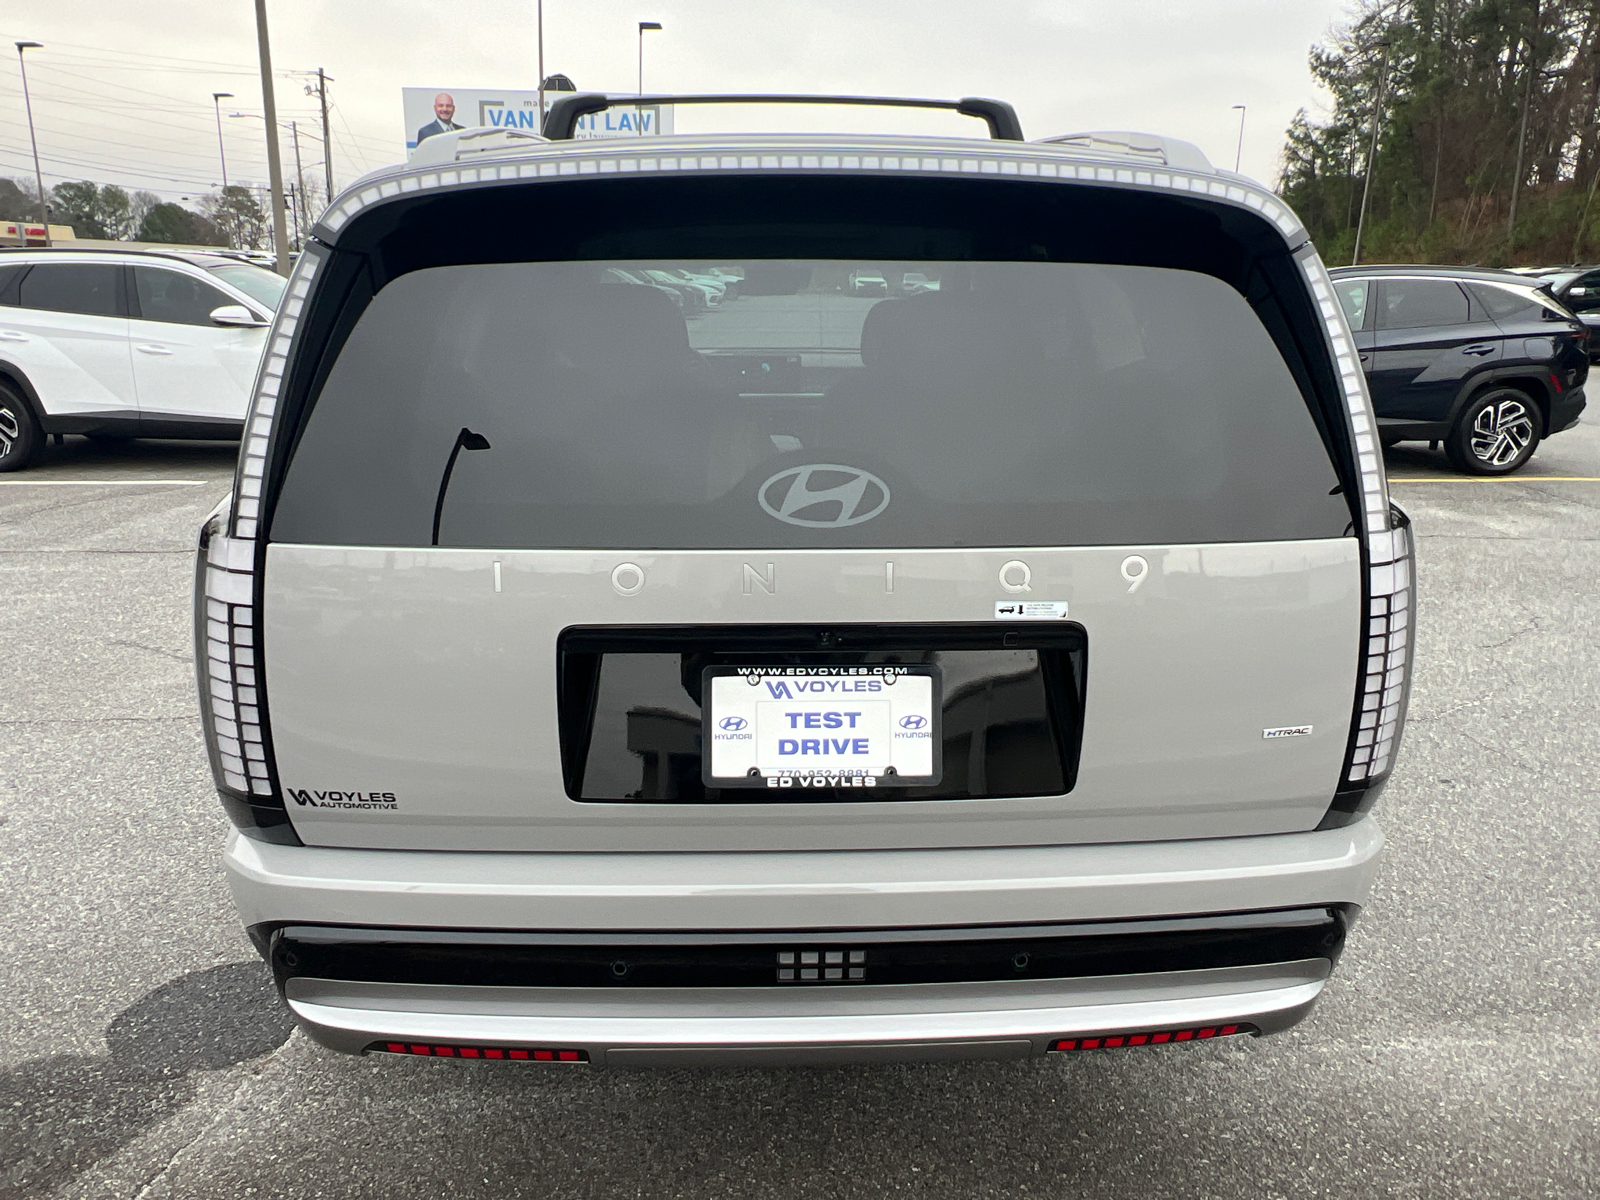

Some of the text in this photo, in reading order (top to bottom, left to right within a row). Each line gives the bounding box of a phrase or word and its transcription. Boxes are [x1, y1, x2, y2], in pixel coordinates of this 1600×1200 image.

[488, 109, 534, 129] VAN
[605, 112, 651, 132] LAW
[1120, 555, 1150, 594] 9
[737, 667, 908, 676] WWW.EDVOYLES.COM
[794, 680, 882, 693] VOYLES
[785, 711, 862, 729] TEST
[895, 731, 932, 739] HYUNDAI
[1266, 727, 1310, 737] HTRAC
[778, 738, 870, 756] DRIVE
[767, 776, 877, 788] ED VOYLES
[313, 790, 397, 803] VOYLES
[319, 802, 399, 810] AUTOMOTIVE
